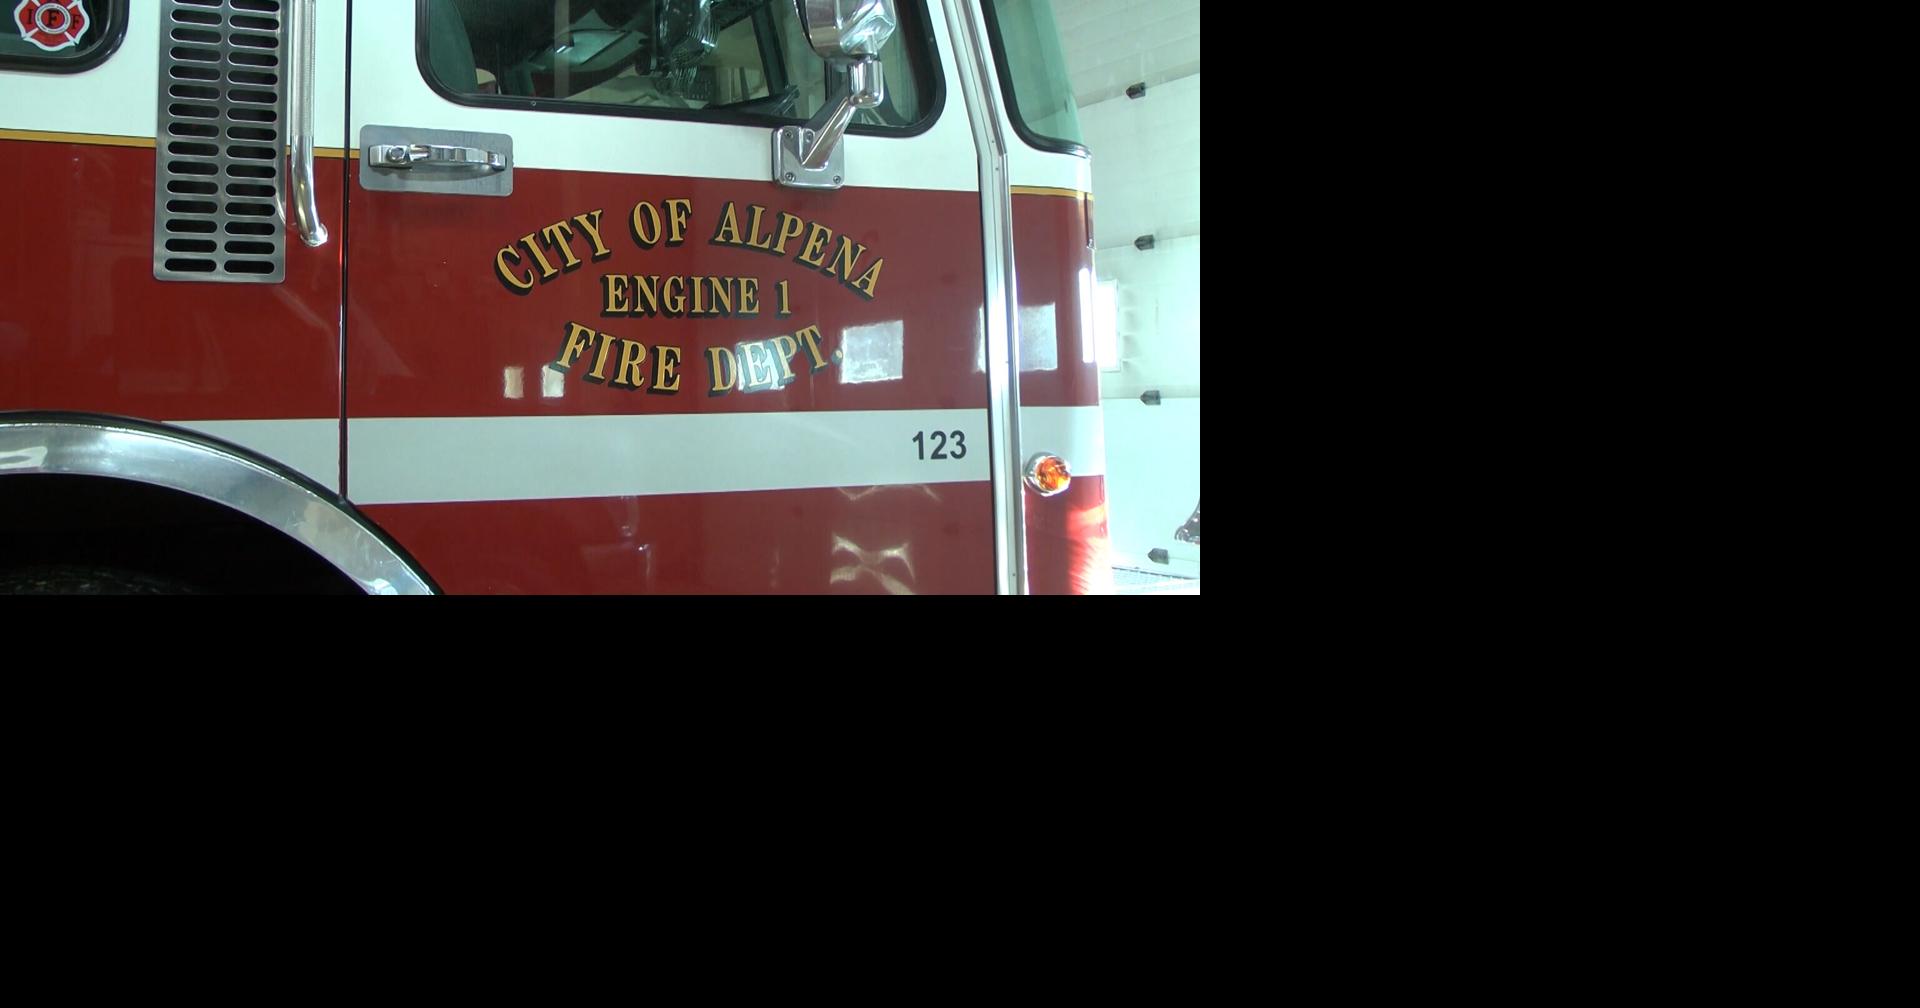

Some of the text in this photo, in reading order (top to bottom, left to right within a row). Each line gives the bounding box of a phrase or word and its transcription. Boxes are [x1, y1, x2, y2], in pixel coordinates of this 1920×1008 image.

[495, 198, 884, 299] CITY OF ALPENA
[603, 274, 792, 316] ENGINE 1
[553, 321, 844, 393] FIRE DEPT.
[912, 430, 967, 460] 123
